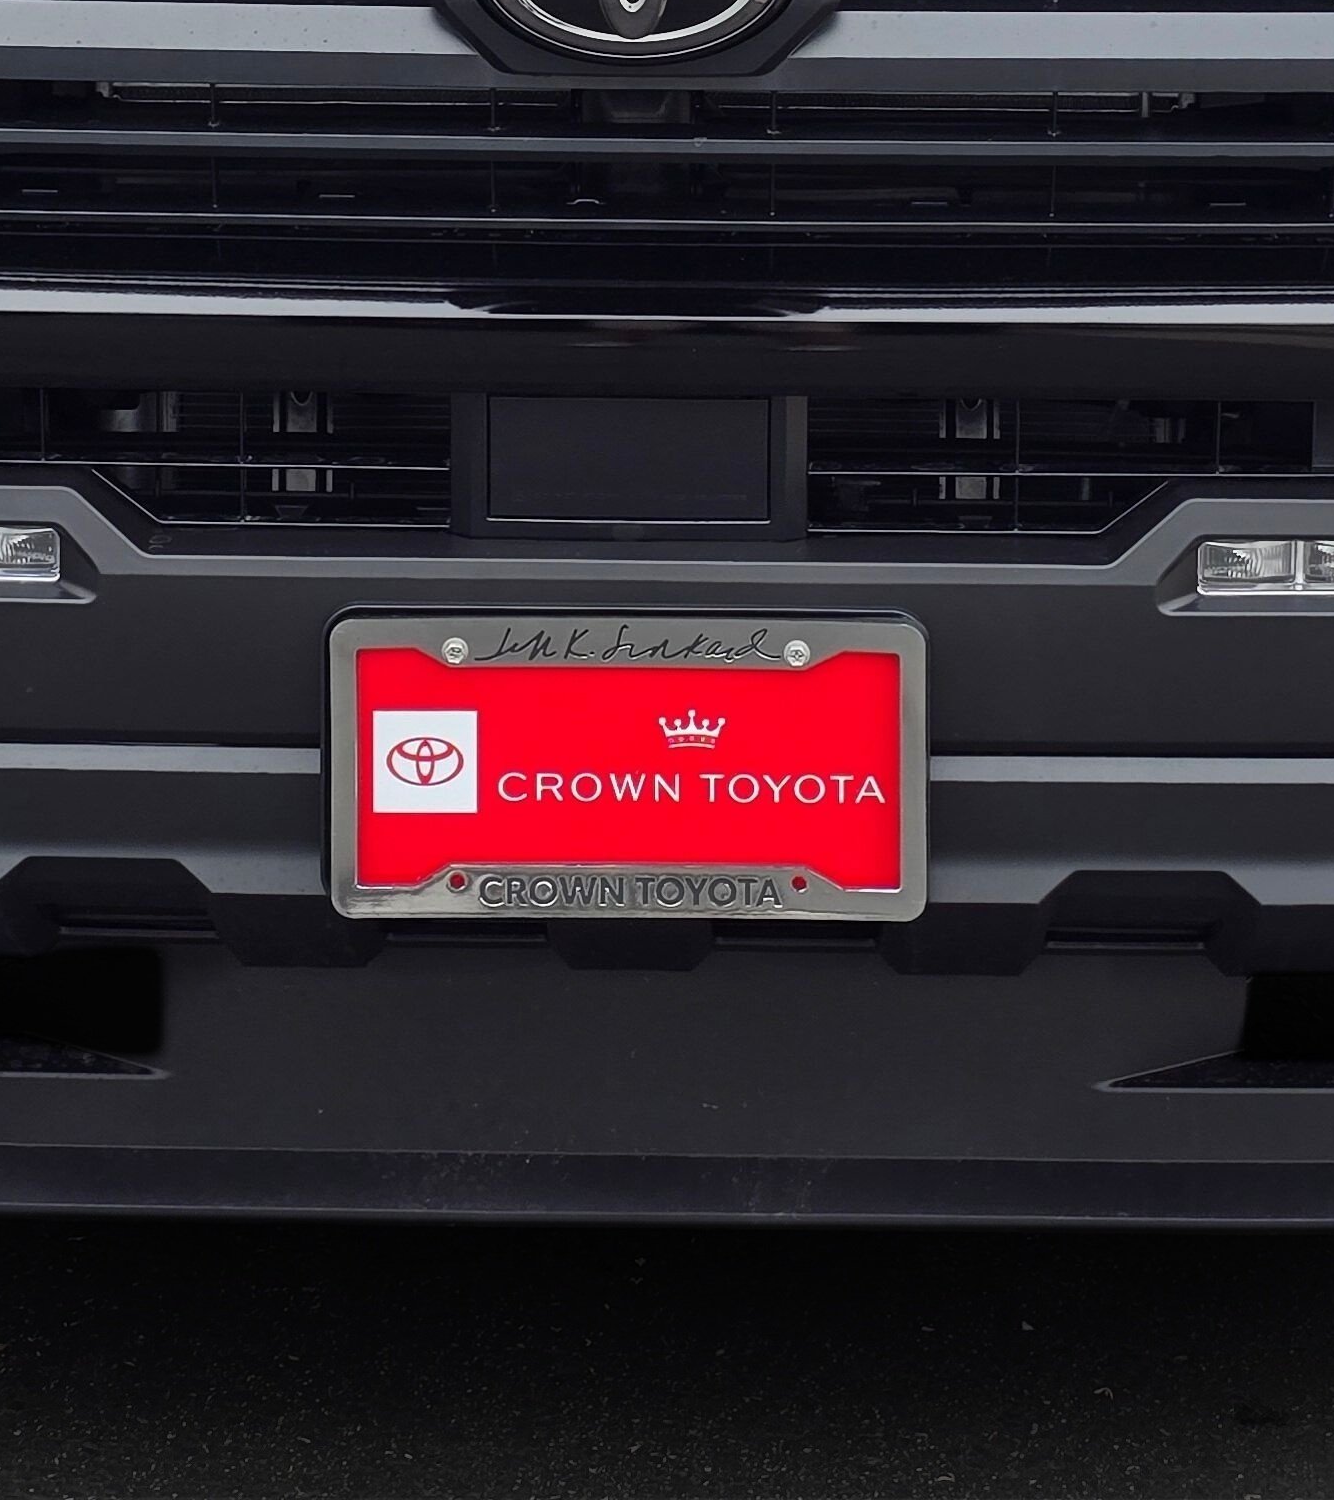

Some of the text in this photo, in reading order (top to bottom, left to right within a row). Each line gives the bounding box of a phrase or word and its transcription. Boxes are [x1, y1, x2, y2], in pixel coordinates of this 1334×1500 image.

[497, 771, 887, 805] CROWN TOYOTA
[478, 875, 784, 909] CROWN TOYOTA
